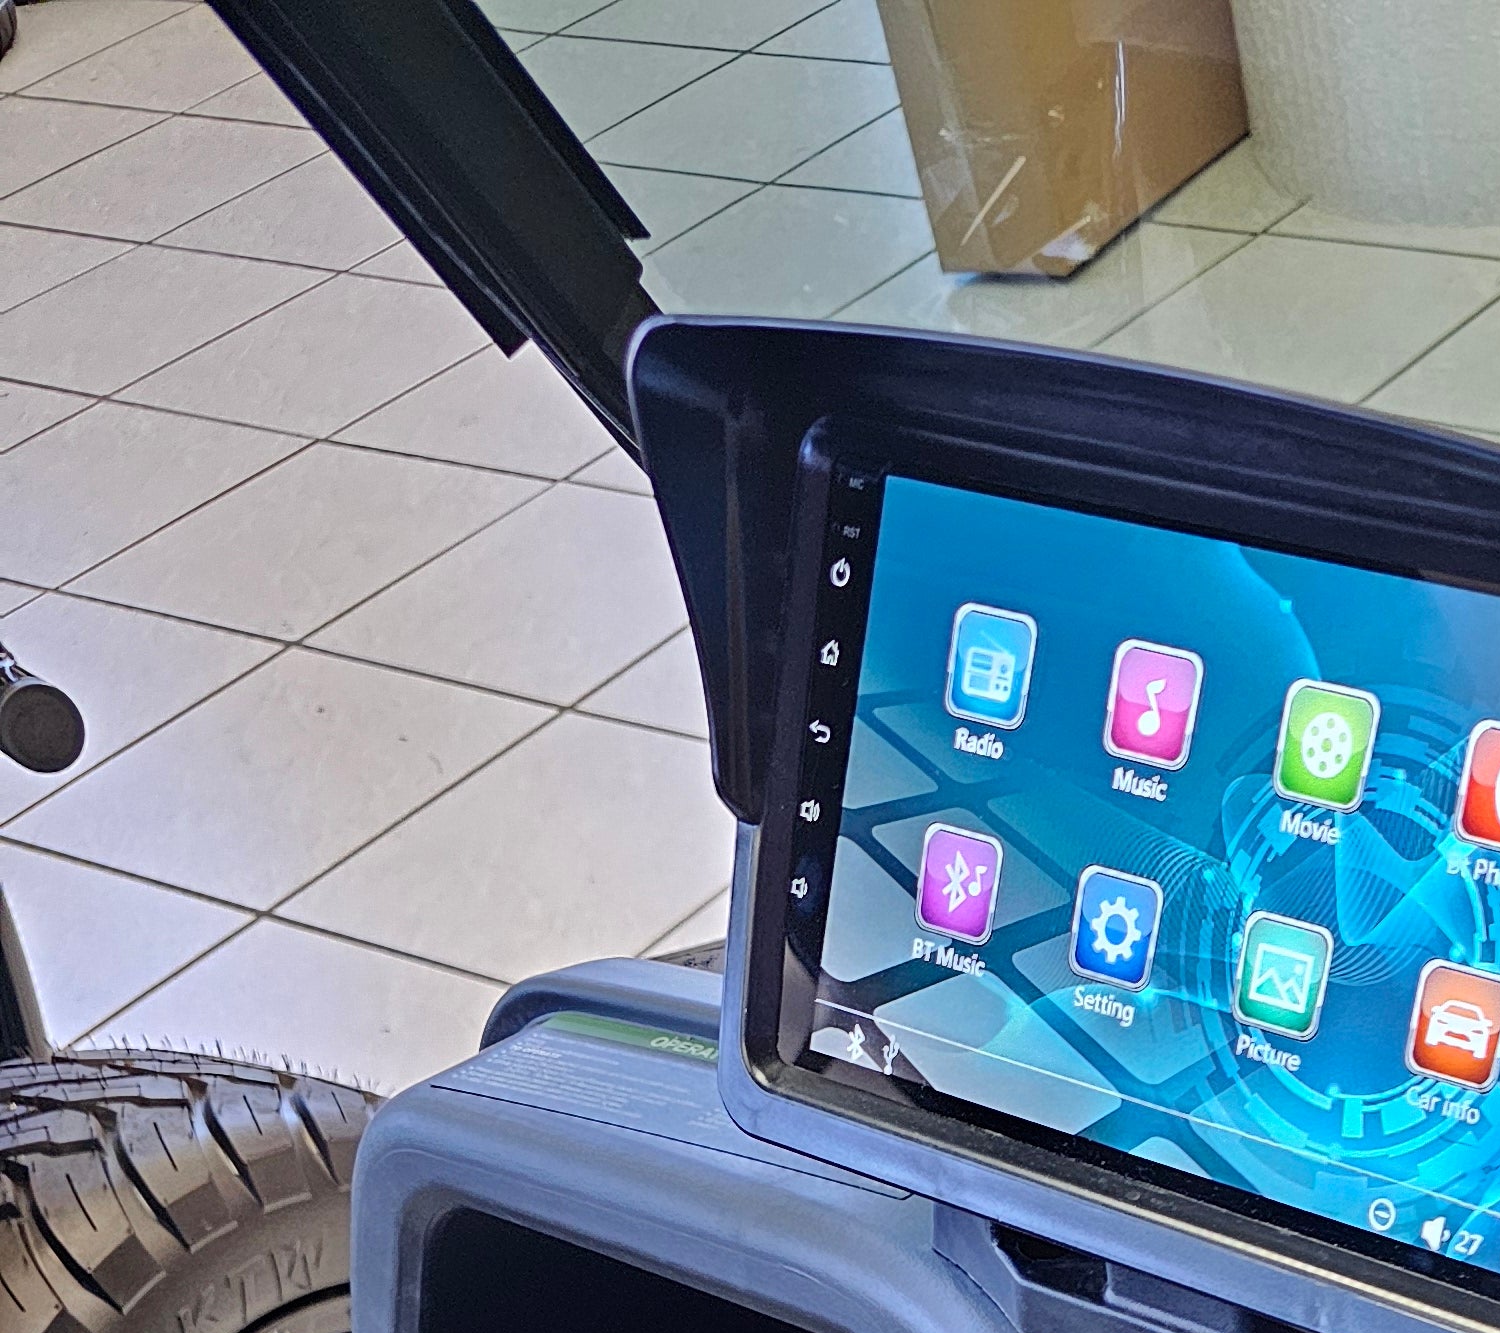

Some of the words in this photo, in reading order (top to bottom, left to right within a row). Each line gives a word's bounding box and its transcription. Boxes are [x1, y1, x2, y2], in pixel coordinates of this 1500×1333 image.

[953, 726, 1004, 760] Radio
[1112, 766, 1168, 802] Music
[1279, 810, 1342, 845] Movie
[912, 938, 935, 962] BT
[935, 945, 986, 977] Music
[1073, 986, 1135, 1028] Setting
[1236, 1034, 1302, 1072] Picture
[1406, 1085, 1440, 1113] Car
[1441, 1097, 1481, 1125] info
[1454, 1230, 1485, 1256] 27
